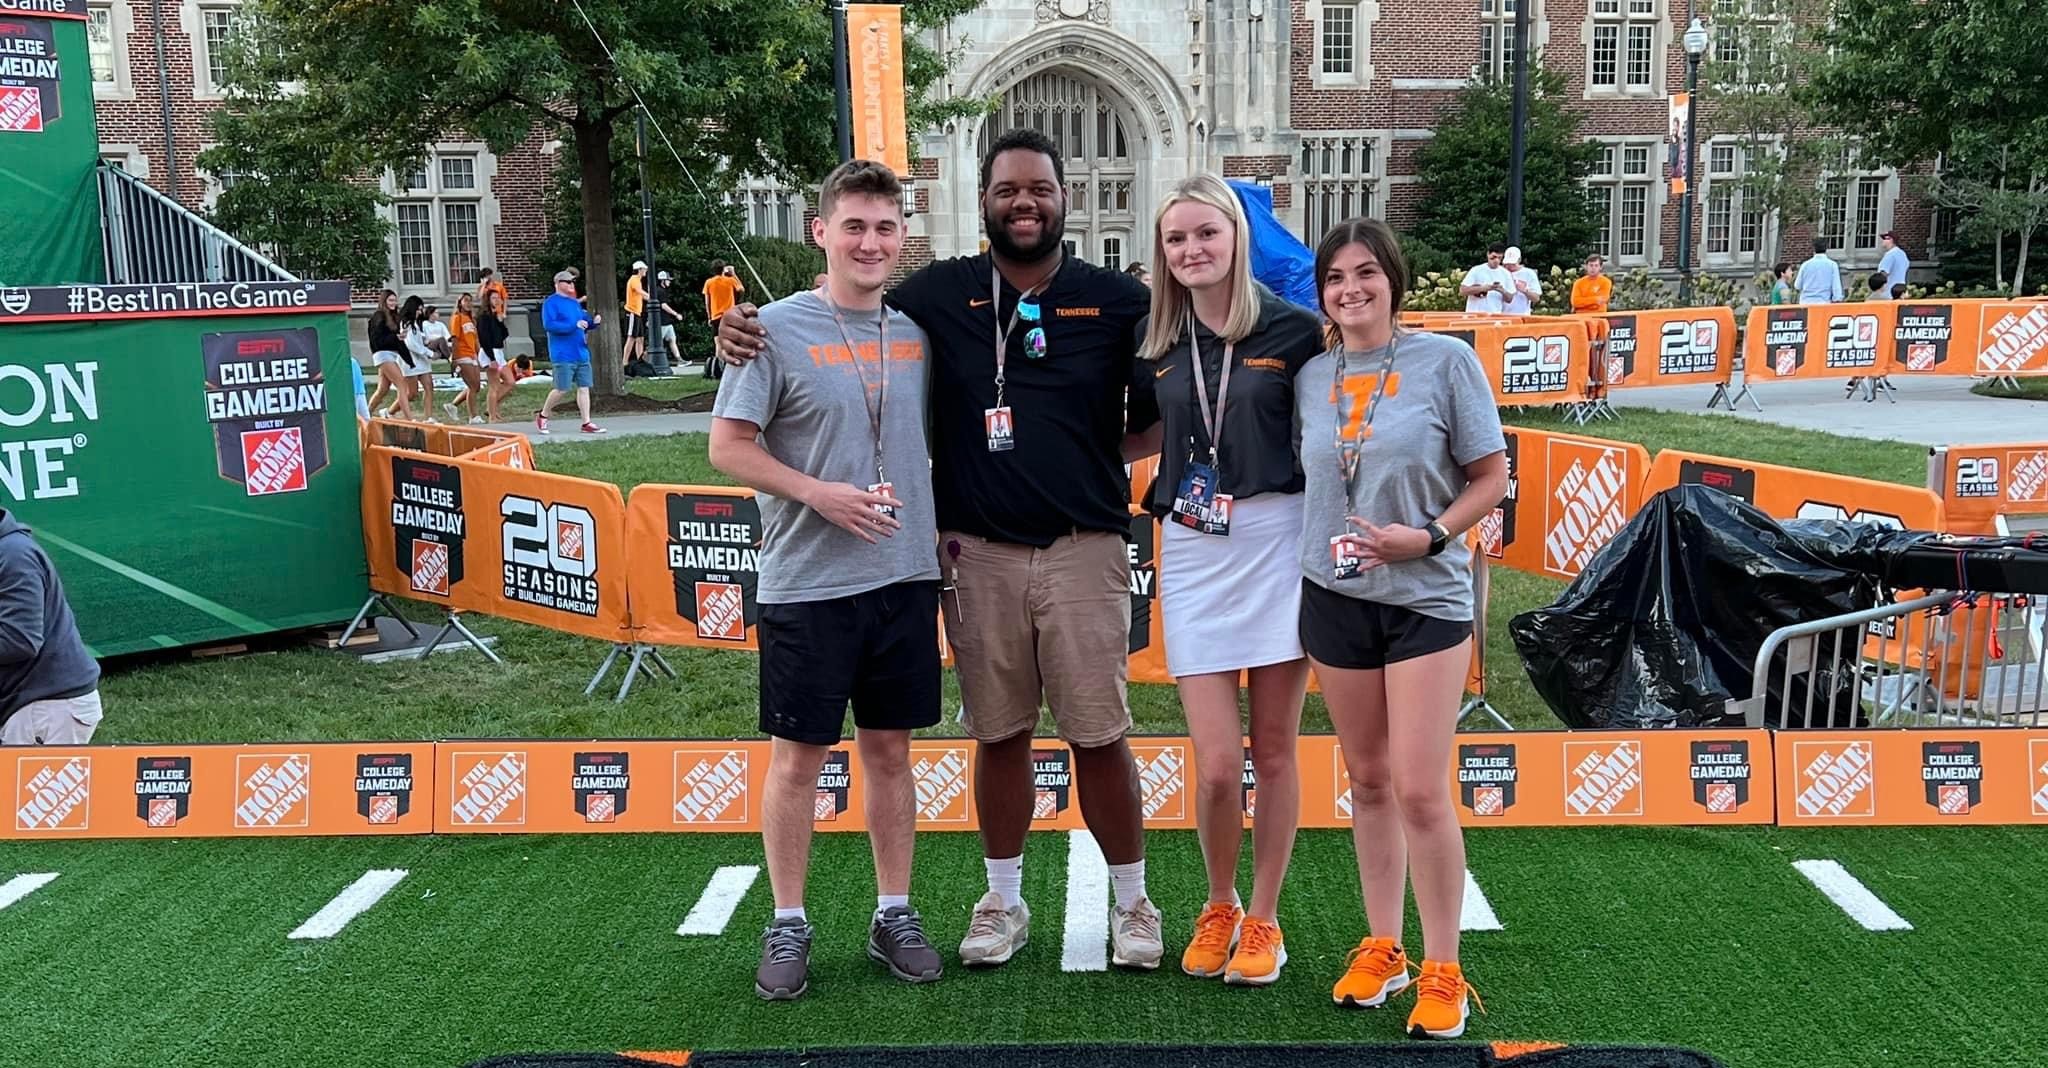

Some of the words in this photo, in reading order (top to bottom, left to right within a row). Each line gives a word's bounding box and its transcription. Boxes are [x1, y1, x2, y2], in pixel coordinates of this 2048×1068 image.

[0, 57, 58, 78] MEDAY
[67, 283, 308, 313] #BestInTheGame
[1056, 307, 1101, 317] TENNESSEE
[1903, 317, 1945, 327] COLLEGE
[1988, 312, 2019, 338] THE
[1610, 328, 1631, 339] LEGE
[1611, 339, 1636, 352] EDAY
[1661, 320, 1719, 356] 20
[1766, 332, 1807, 345] GAMEDAY
[1828, 316, 1878, 349] 20
[1895, 328, 1950, 340] GAMEDAY
[1980, 304, 2048, 370] HOME
[237, 339, 285, 355] ESPN
[1504, 336, 1569, 374] 20
[1660, 354, 1716, 367] SEASONS
[1827, 349, 1876, 361] SEASONS
[220, 358, 309, 386] COLLEGE
[1503, 373, 1567, 386] SEASONS
[207, 383, 325, 419] GAMEDAY
[274, 419, 285, 428] BY
[248, 430, 300, 493] HOME
[251, 438, 273, 462] THE
[270, 451, 304, 491] DEPOT
[412, 467, 440, 481] ESPN
[1555, 457, 1587, 508] THE
[1702, 471, 1732, 488] ESPN
[1957, 458, 1999, 483] 20
[2008, 452, 2048, 500] HOME
[401, 482, 455, 509] COLLEGE
[1956, 484, 1999, 493] SEASONS
[393, 503, 463, 536] GAMEDAY
[694, 502, 733, 517] ESPN
[1181, 501, 1203, 518] LOCAL
[1547, 448, 1625, 570] HOME
[501, 496, 597, 577] 20
[679, 521, 751, 543] COLLEGE
[413, 543, 448, 589] HOME
[417, 546, 432, 565] THE
[669, 545, 762, 572] GAMEDAY
[427, 563, 448, 592] DEPOT
[504, 564, 598, 601] SEASONS
[505, 586, 516, 598] OF
[518, 589, 554, 606] BUILDING
[556, 598, 598, 615] GAMEDAY
[699, 585, 741, 636] HOME
[702, 590, 721, 611] THE
[717, 605, 742, 637] DEPOT
[363, 767, 405, 777] COLLEGE
[580, 766, 622, 775] COLLEGE
[912, 757, 933, 780] HE
[1034, 762, 1063, 772] LLEGE
[1466, 757, 1509, 768] COLLEGE
[1572, 750, 1604, 779] THE
[1691, 765, 1750, 778] GAMEDAY
[1698, 754, 1742, 764] COLLEGE
[1803, 750, 1835, 779] THE
[1929, 755, 1974, 766] COLLEGE
[25, 765, 54, 794] THE
[143, 770, 184, 780] COLLEGE
[244, 763, 274, 791] THE
[356, 778, 411, 790] GAMEDAY
[460, 760, 490, 788] THE
[573, 777, 628, 789] GAMEDAY
[675, 751, 747, 822] HOME
[682, 759, 712, 787] THE
[818, 775, 849, 787] EDAY
[1035, 773, 1069, 786] MEDAY
[1459, 769, 1517, 782] GAMEDAY
[1567, 741, 1640, 815] HOME
[1798, 742, 1872, 816] HOME
[1922, 767, 1981, 780] GAMEDAY
[18, 758, 89, 829] HOME
[136, 781, 191, 794] GAMEDAY
[237, 755, 309, 825] HOME
[453, 753, 525, 824] HOME
[702, 778, 746, 822] DEPOT
[924, 776, 967, 820] DEPOT
[1142, 775, 1183, 818] DEPOT
[1596, 769, 1641, 815] DEPOT
[1827, 769, 1872, 816] DEPOT
[45, 784, 89, 829] DEPOT
[264, 781, 308, 825] DEPOT
[480, 780, 524, 824] DEPOT
